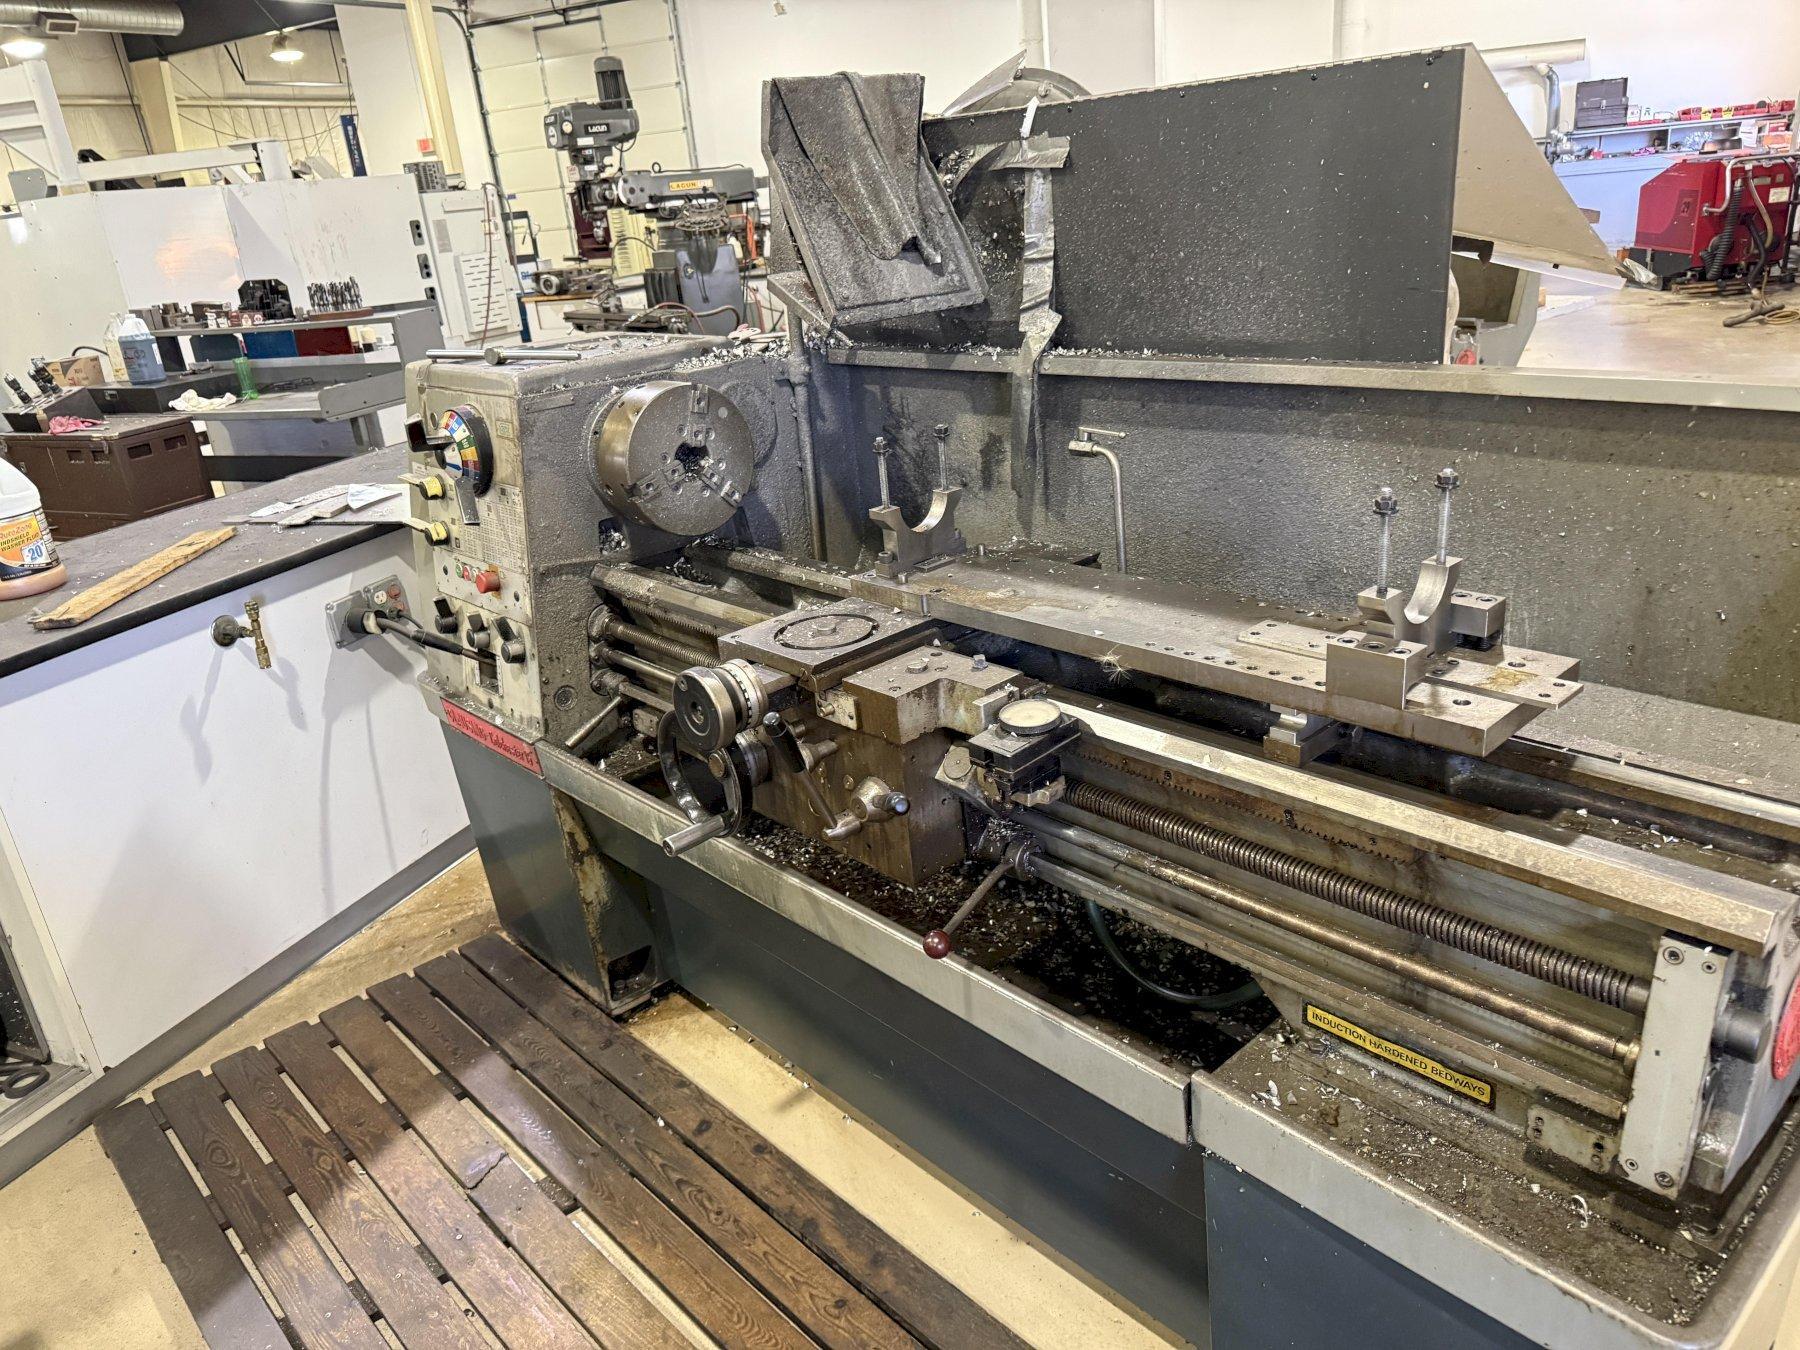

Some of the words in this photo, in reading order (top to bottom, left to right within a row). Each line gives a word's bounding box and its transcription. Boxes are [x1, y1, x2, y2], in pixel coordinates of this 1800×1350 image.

[0, 531, 30, 547] INDSHIELD
[1, 539, 26, 552] WASHER
[1312, 1010, 1367, 1046] INDUCTION
[1369, 1036, 1428, 1070] HARDENED
[1431, 1066, 1486, 1096] BEDWAYS
